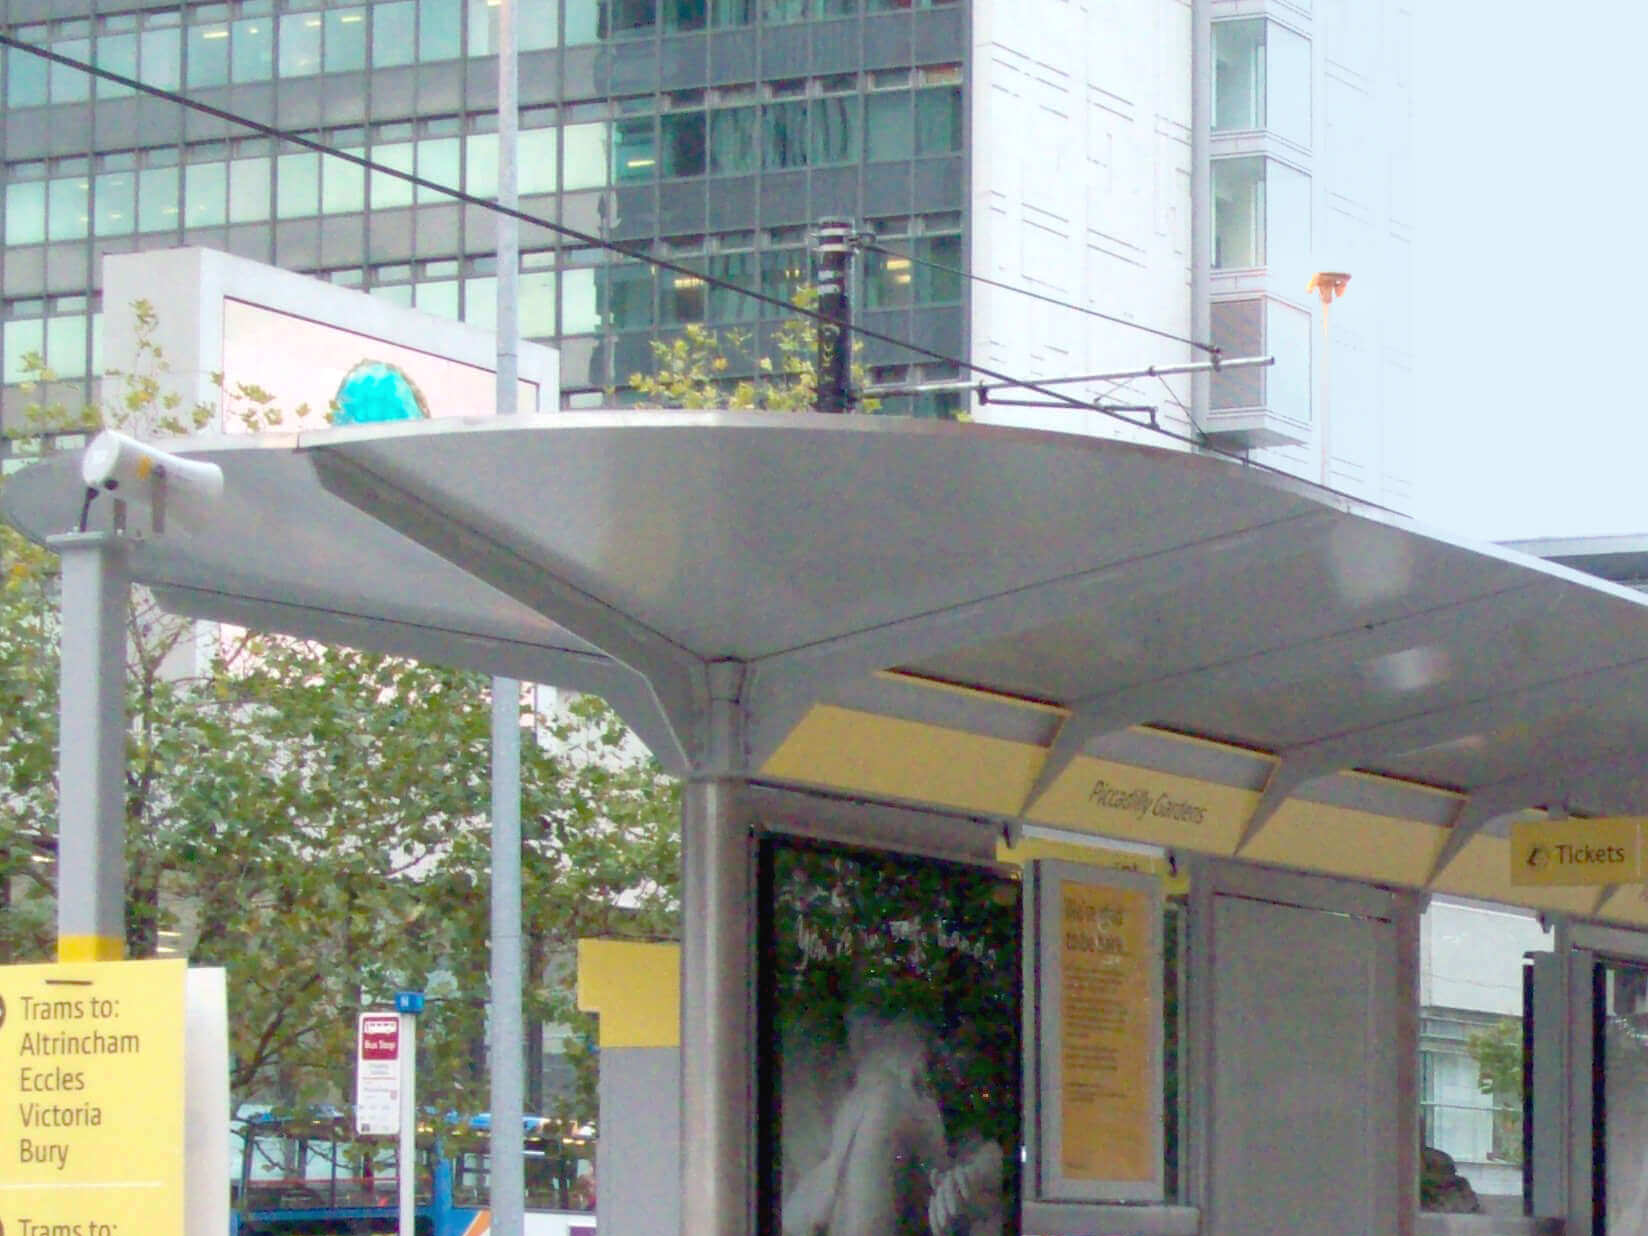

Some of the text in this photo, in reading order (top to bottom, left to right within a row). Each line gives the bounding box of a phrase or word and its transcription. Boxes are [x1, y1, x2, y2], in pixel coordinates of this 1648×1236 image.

[1088, 779, 1209, 825] Piccadilly Gardens
[1555, 844, 1625, 866] Tickets
[20, 996, 120, 1021] Trams to:
[19, 1030, 141, 1057] Altrincham
[20, 1065, 86, 1093] Eccles
[19, 1102, 103, 1128] Victoria
[19, 1138, 70, 1171] Bury
